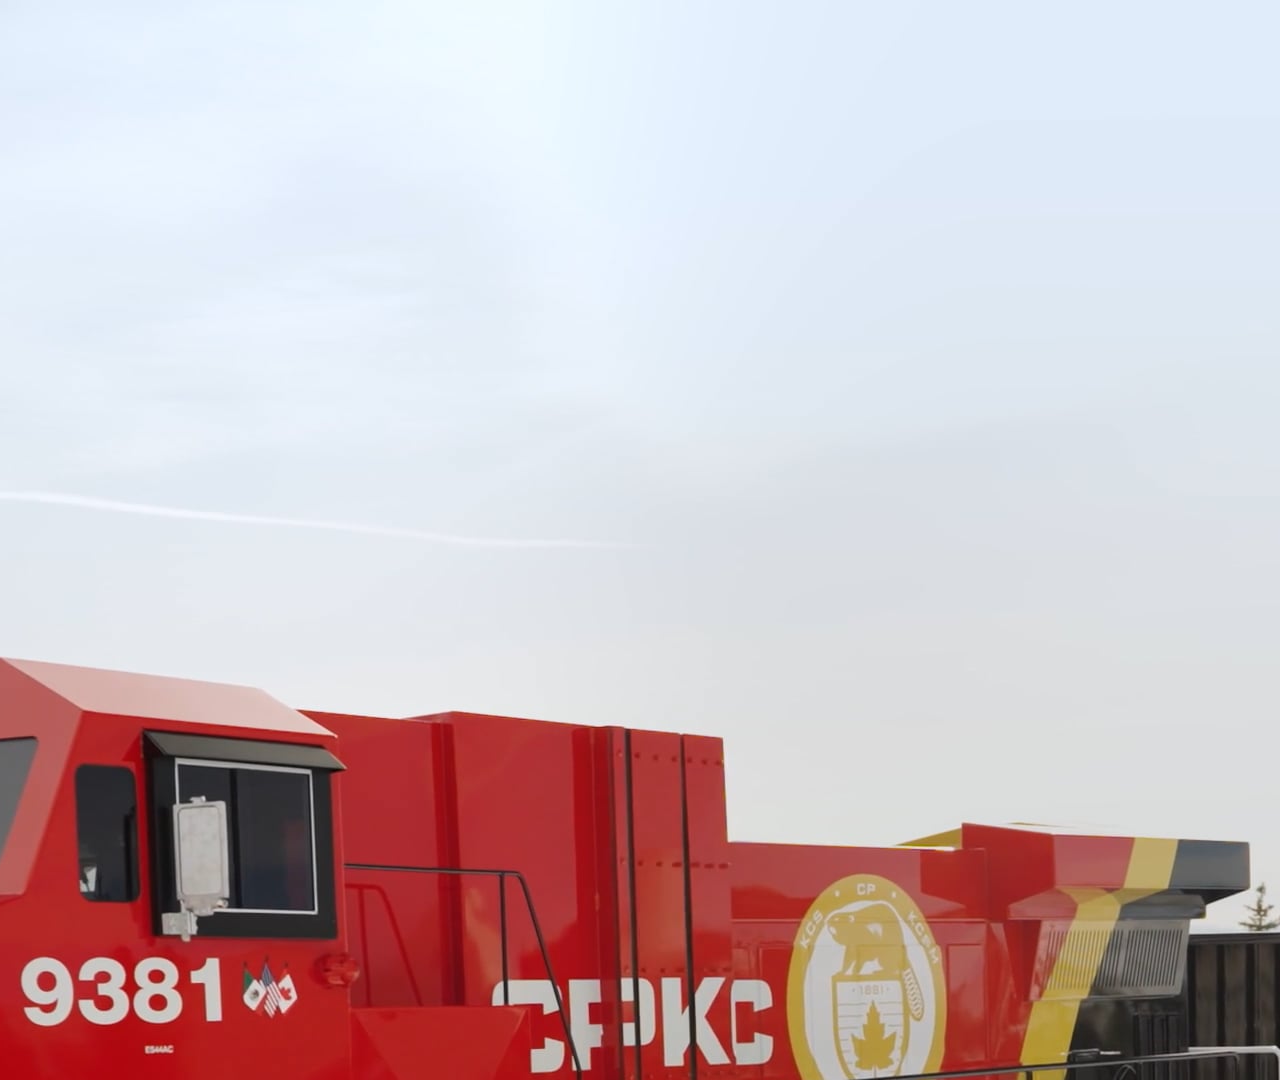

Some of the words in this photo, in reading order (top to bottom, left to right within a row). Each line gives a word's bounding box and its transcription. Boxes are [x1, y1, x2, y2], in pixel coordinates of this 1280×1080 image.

[856, 883, 877, 896] CP
[799, 910, 824, 949] KCS
[20, 956, 223, 1027] 9381
[491, 976, 774, 1074] CPKC
